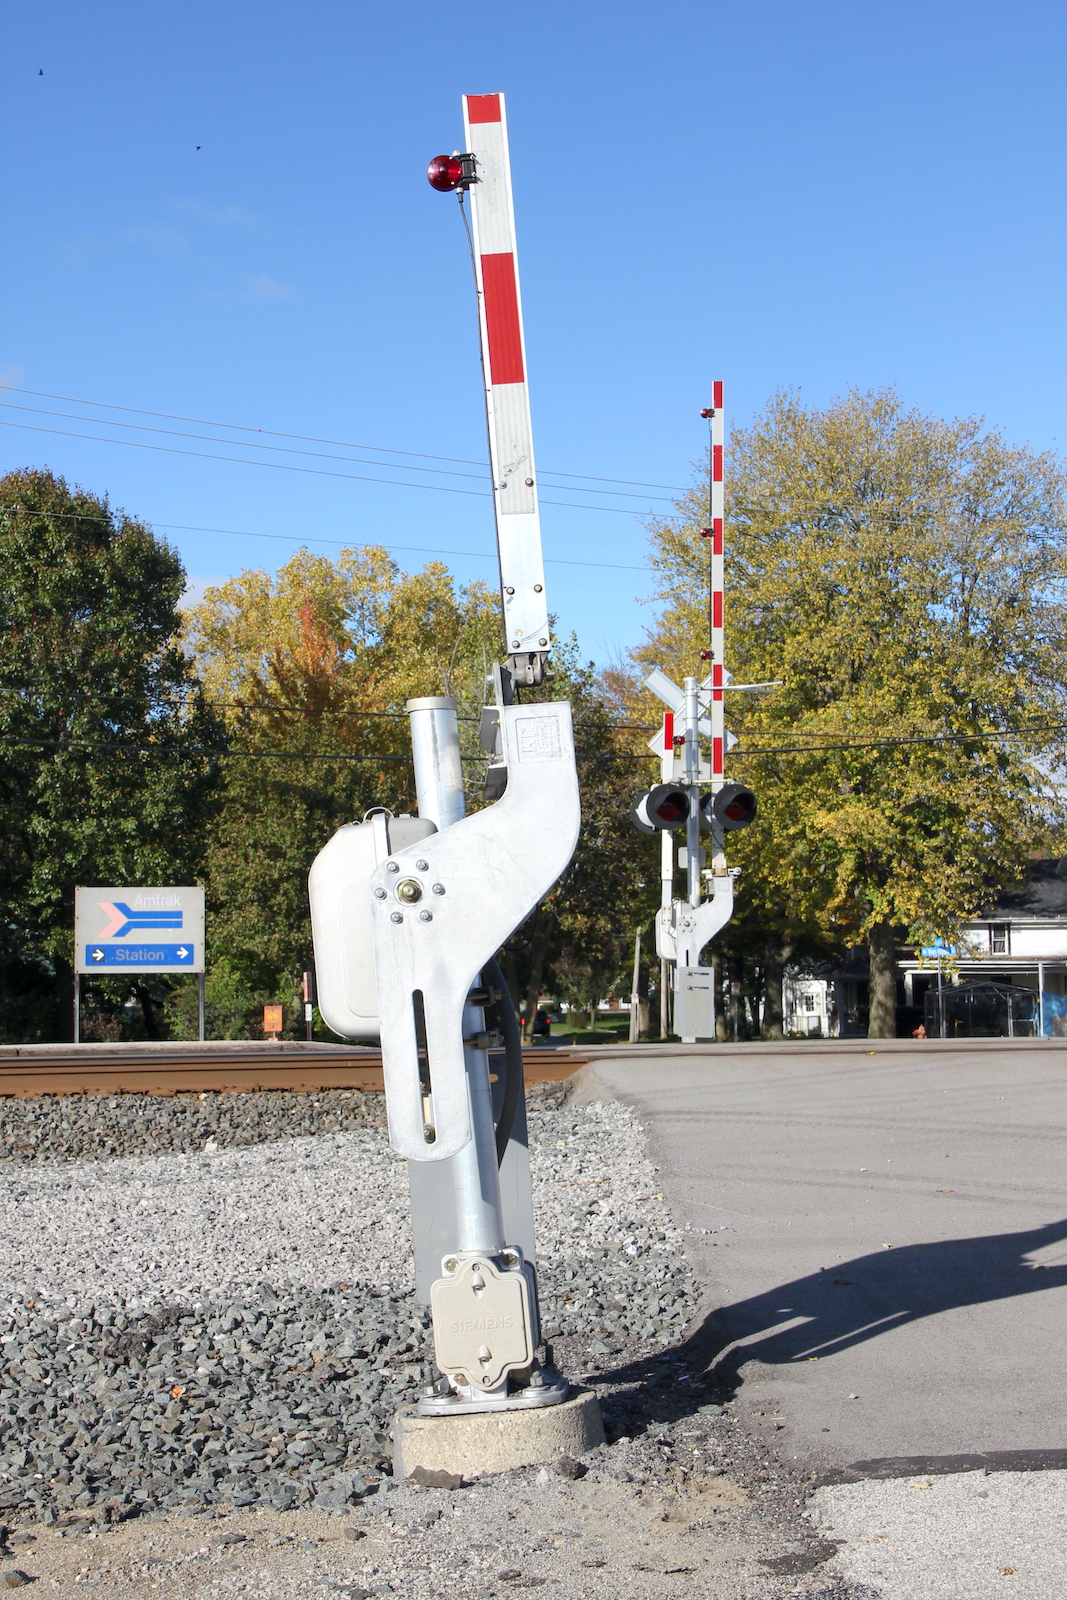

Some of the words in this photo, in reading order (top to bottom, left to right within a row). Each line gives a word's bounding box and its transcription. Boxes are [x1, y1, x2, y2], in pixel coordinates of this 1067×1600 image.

[134, 894, 182, 907] Amtrak
[115, 949, 165, 961] Station
[450, 1317, 514, 1333] SIEMENS
